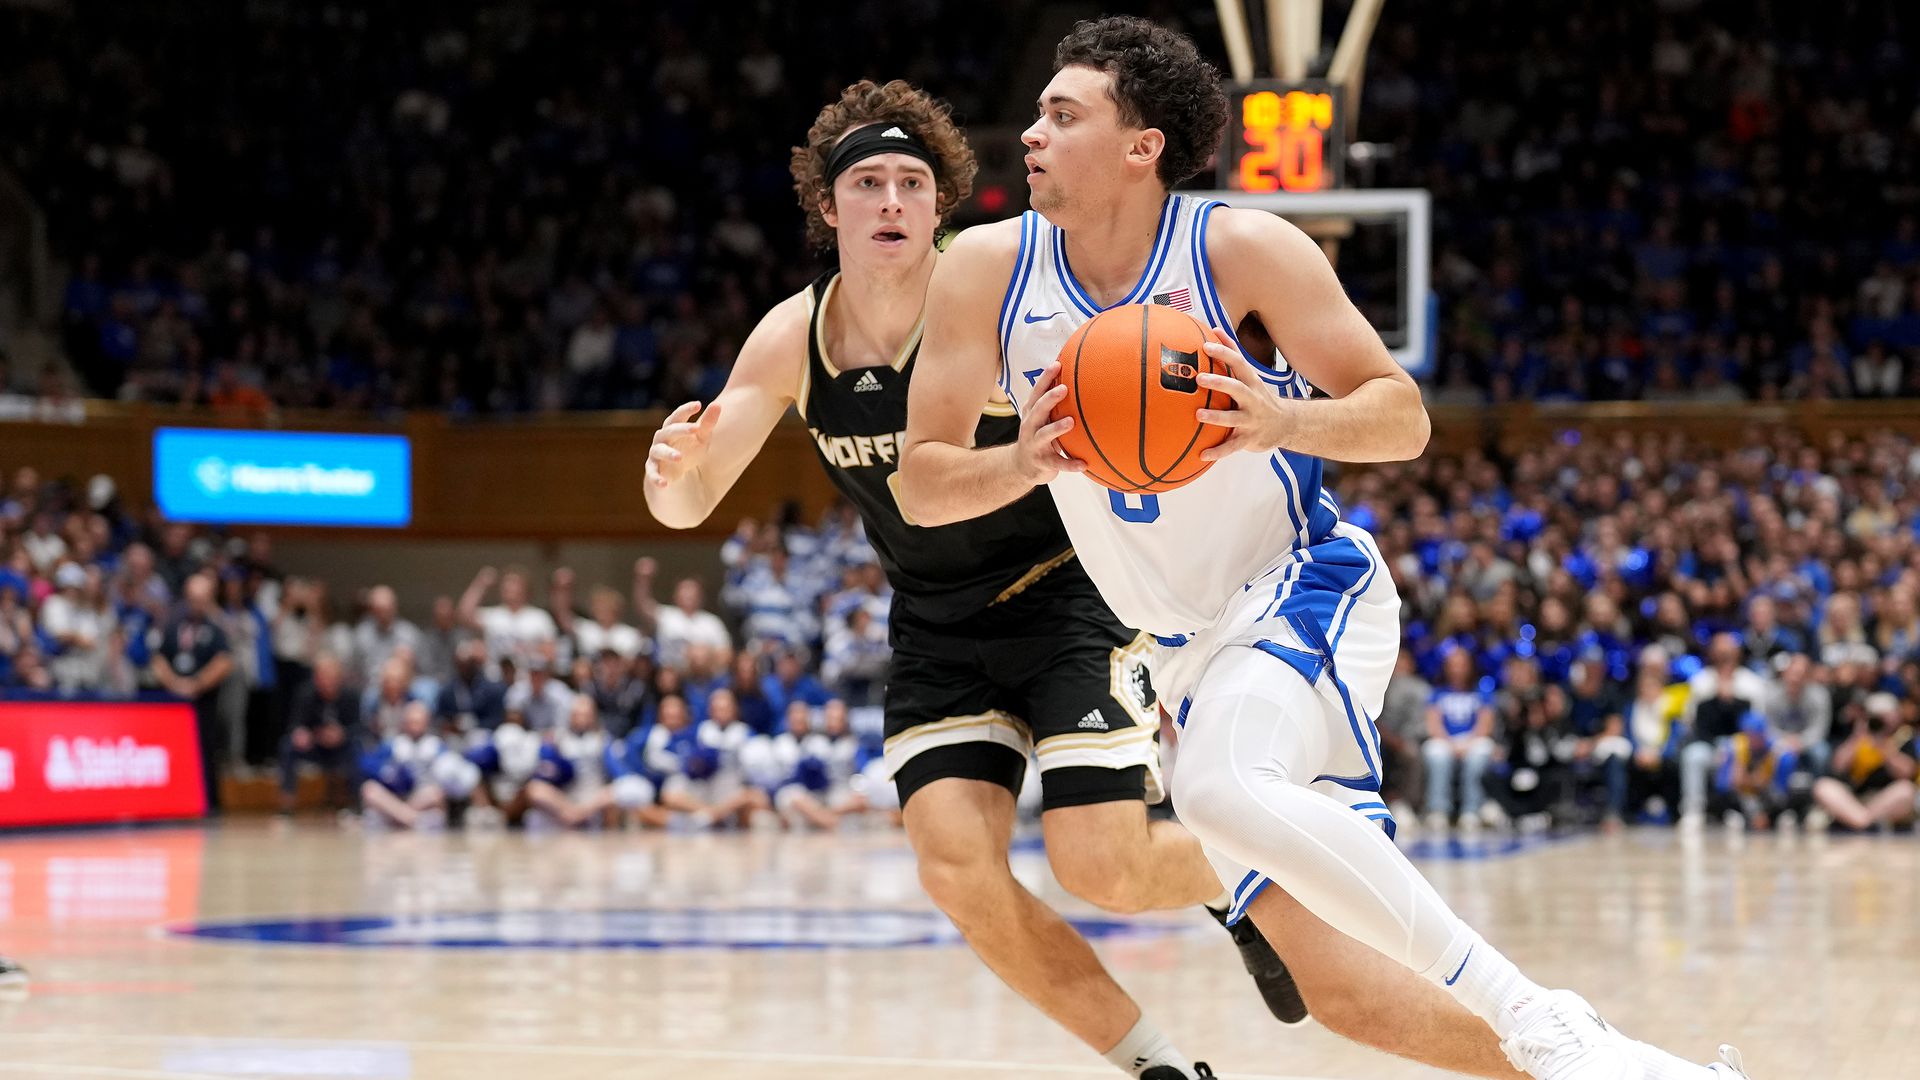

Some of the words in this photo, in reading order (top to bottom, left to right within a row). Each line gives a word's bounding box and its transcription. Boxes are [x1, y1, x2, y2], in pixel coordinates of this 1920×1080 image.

[1240, 128, 1323, 194] 20
[853, 382, 883, 393] adidas
[1077, 720, 1109, 731] adidas
